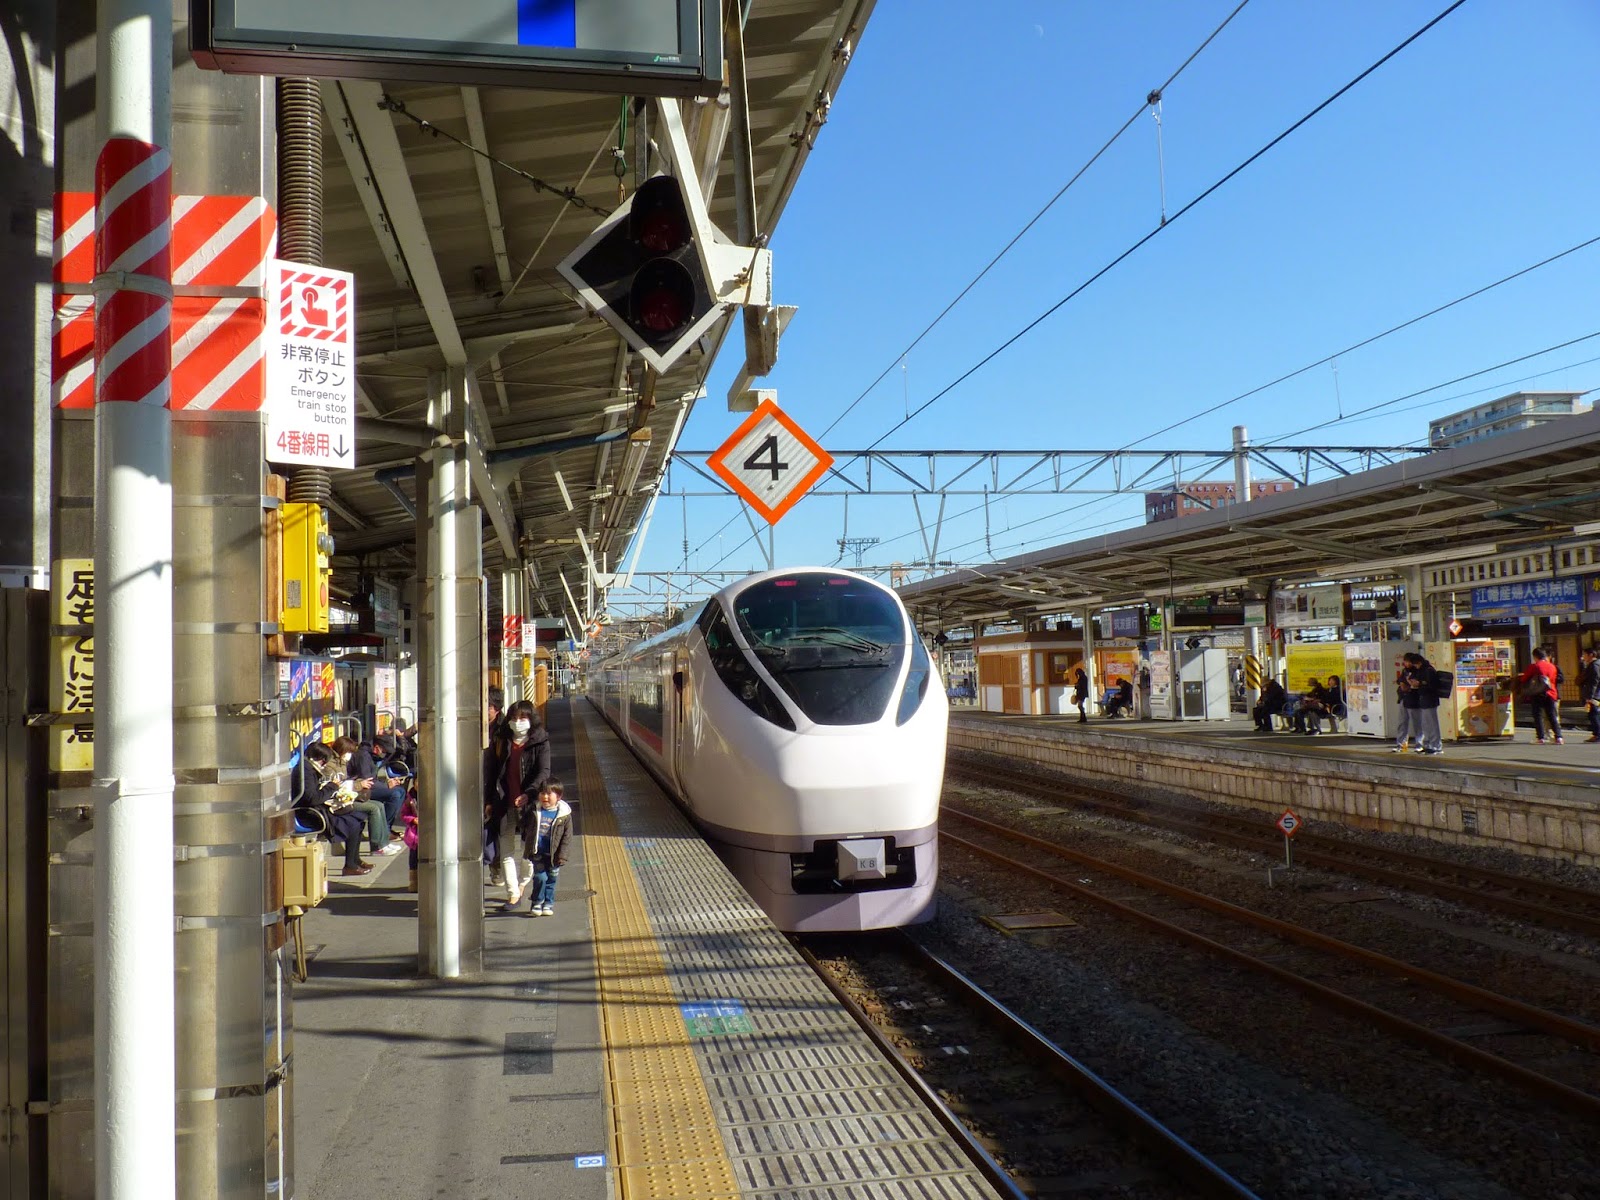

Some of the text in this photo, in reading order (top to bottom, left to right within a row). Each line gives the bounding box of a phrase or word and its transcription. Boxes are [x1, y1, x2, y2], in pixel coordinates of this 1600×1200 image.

[281, 343, 346, 367] 非常停止
[298, 367, 346, 387] ボタン
[290, 385, 347, 402] Emergency
[297, 400, 347, 414] train stop
[314, 413, 347, 425] button
[276, 430, 330, 458] 4番線用
[743, 434, 789, 481] 4
[557, 618, 564, 627] 4
